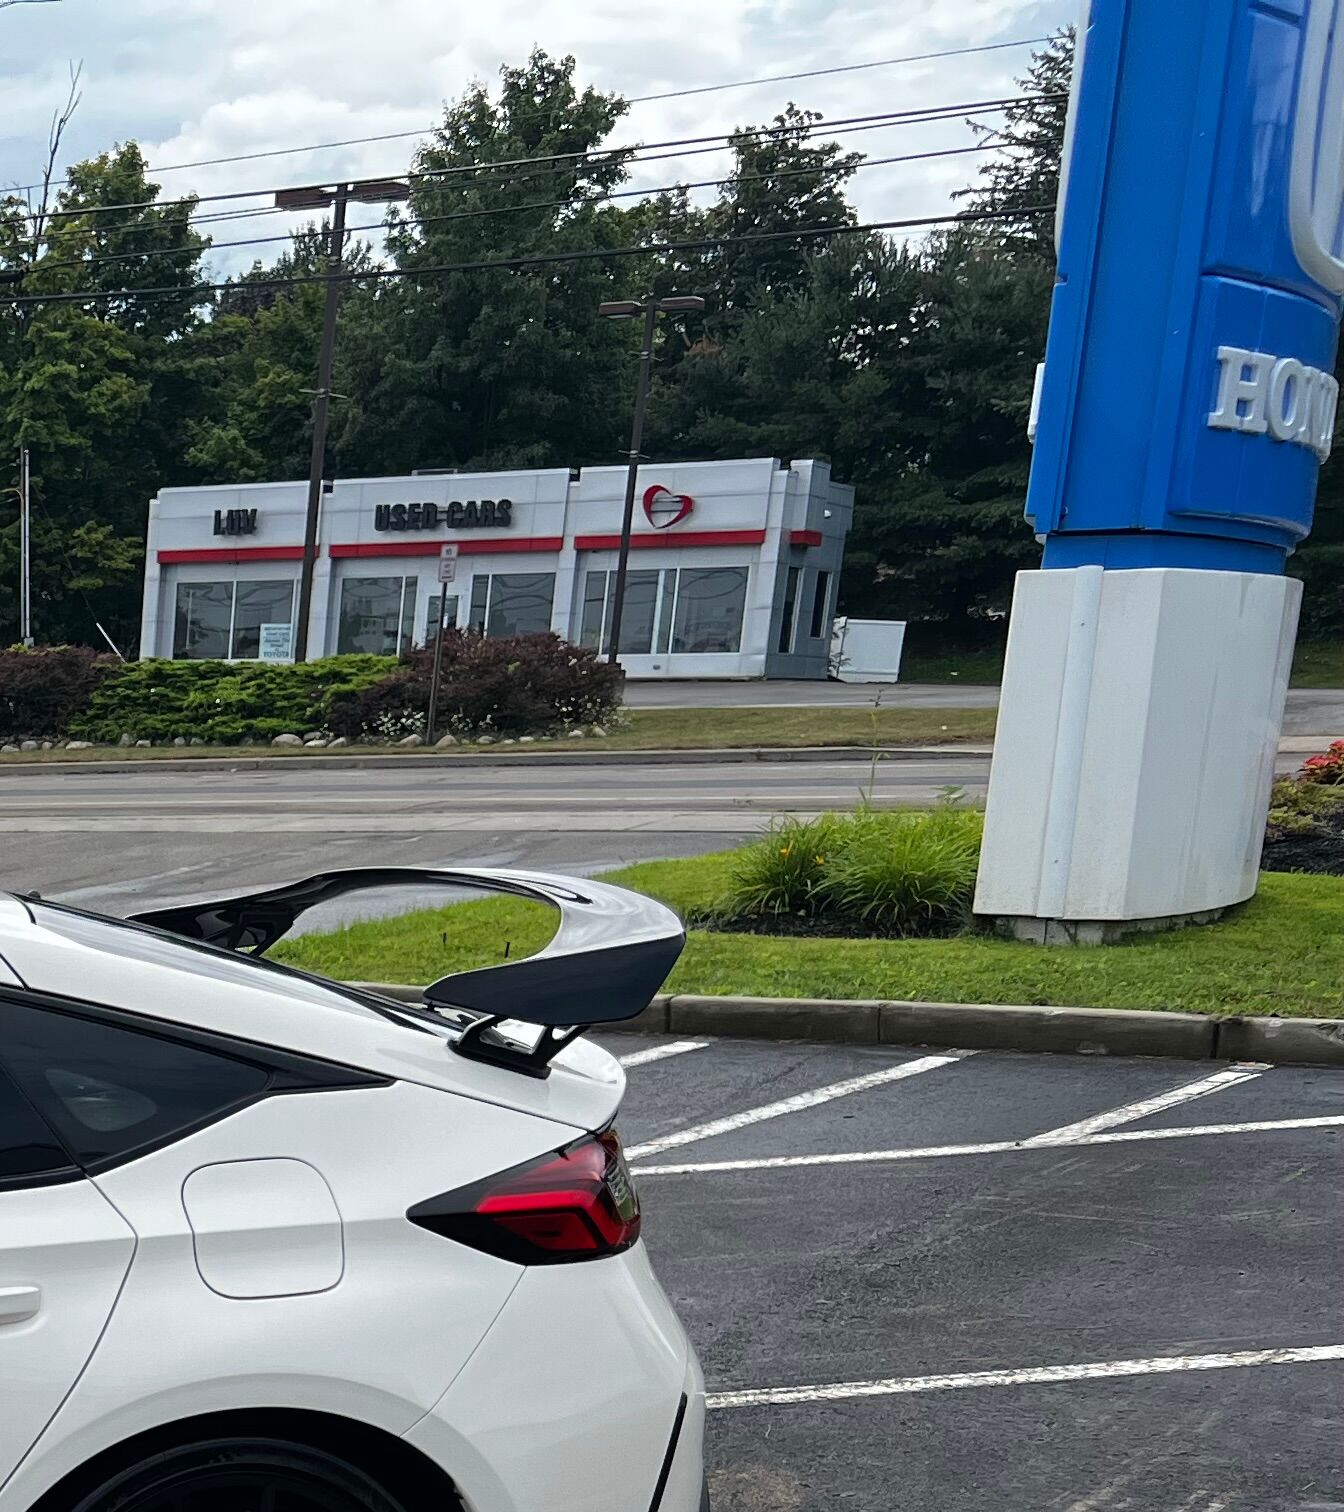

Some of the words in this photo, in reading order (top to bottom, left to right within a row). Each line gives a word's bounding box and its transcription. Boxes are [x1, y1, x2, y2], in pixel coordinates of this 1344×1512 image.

[213, 508, 258, 536] LUV
[374, 502, 439, 531] USED
[446, 499, 512, 529] CARS
